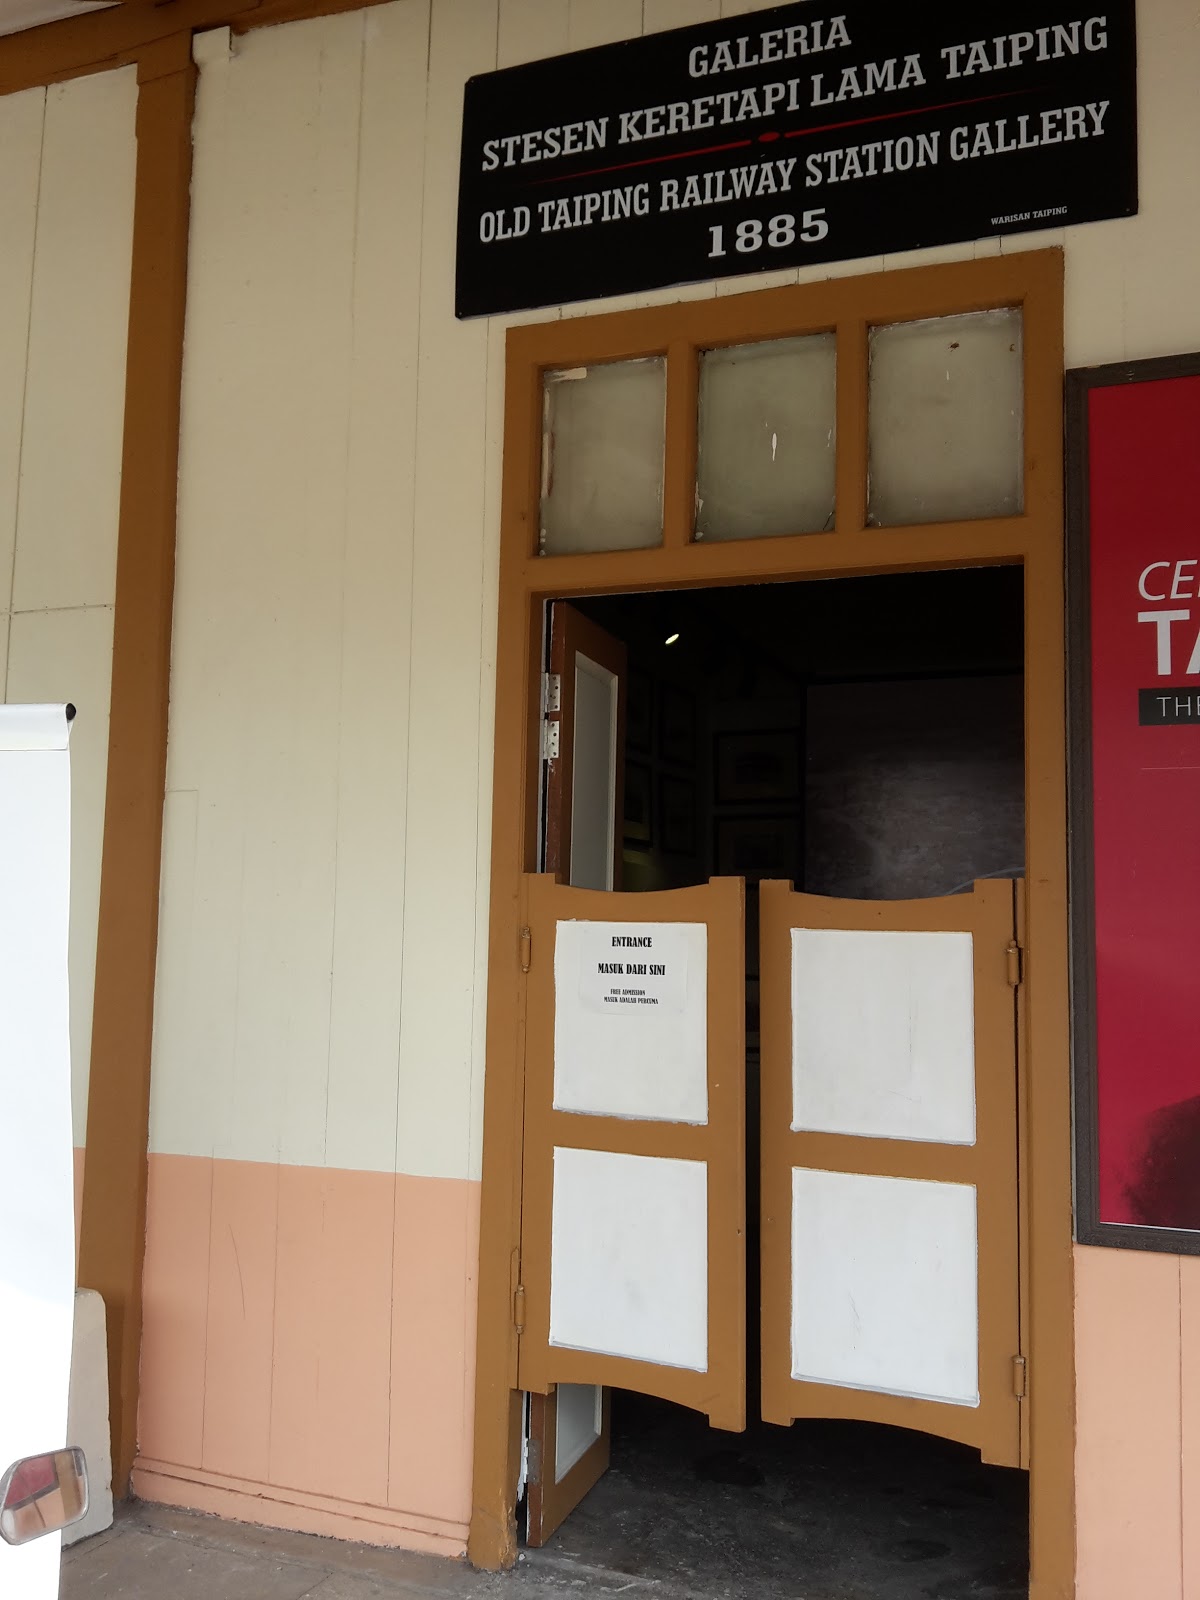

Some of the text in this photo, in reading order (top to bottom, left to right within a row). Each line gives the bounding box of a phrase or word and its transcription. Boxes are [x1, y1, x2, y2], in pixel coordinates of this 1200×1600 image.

[688, 15, 852, 79] GALERIA
[481, 16, 1108, 171] STESEN KERETAPI LAMA TAIPING
[479, 100, 1110, 243] OLD TAIPING RAILWAY STATION GALLERY
[707, 207, 829, 258] 1885
[991, 206, 1067, 225] WARISAN TAIPING
[1137, 559, 1200, 600] CE
[1137, 609, 1200, 675] T
[611, 936, 652, 947] ENTRANCE
[598, 963, 665, 975] MASUK DARI SINI
